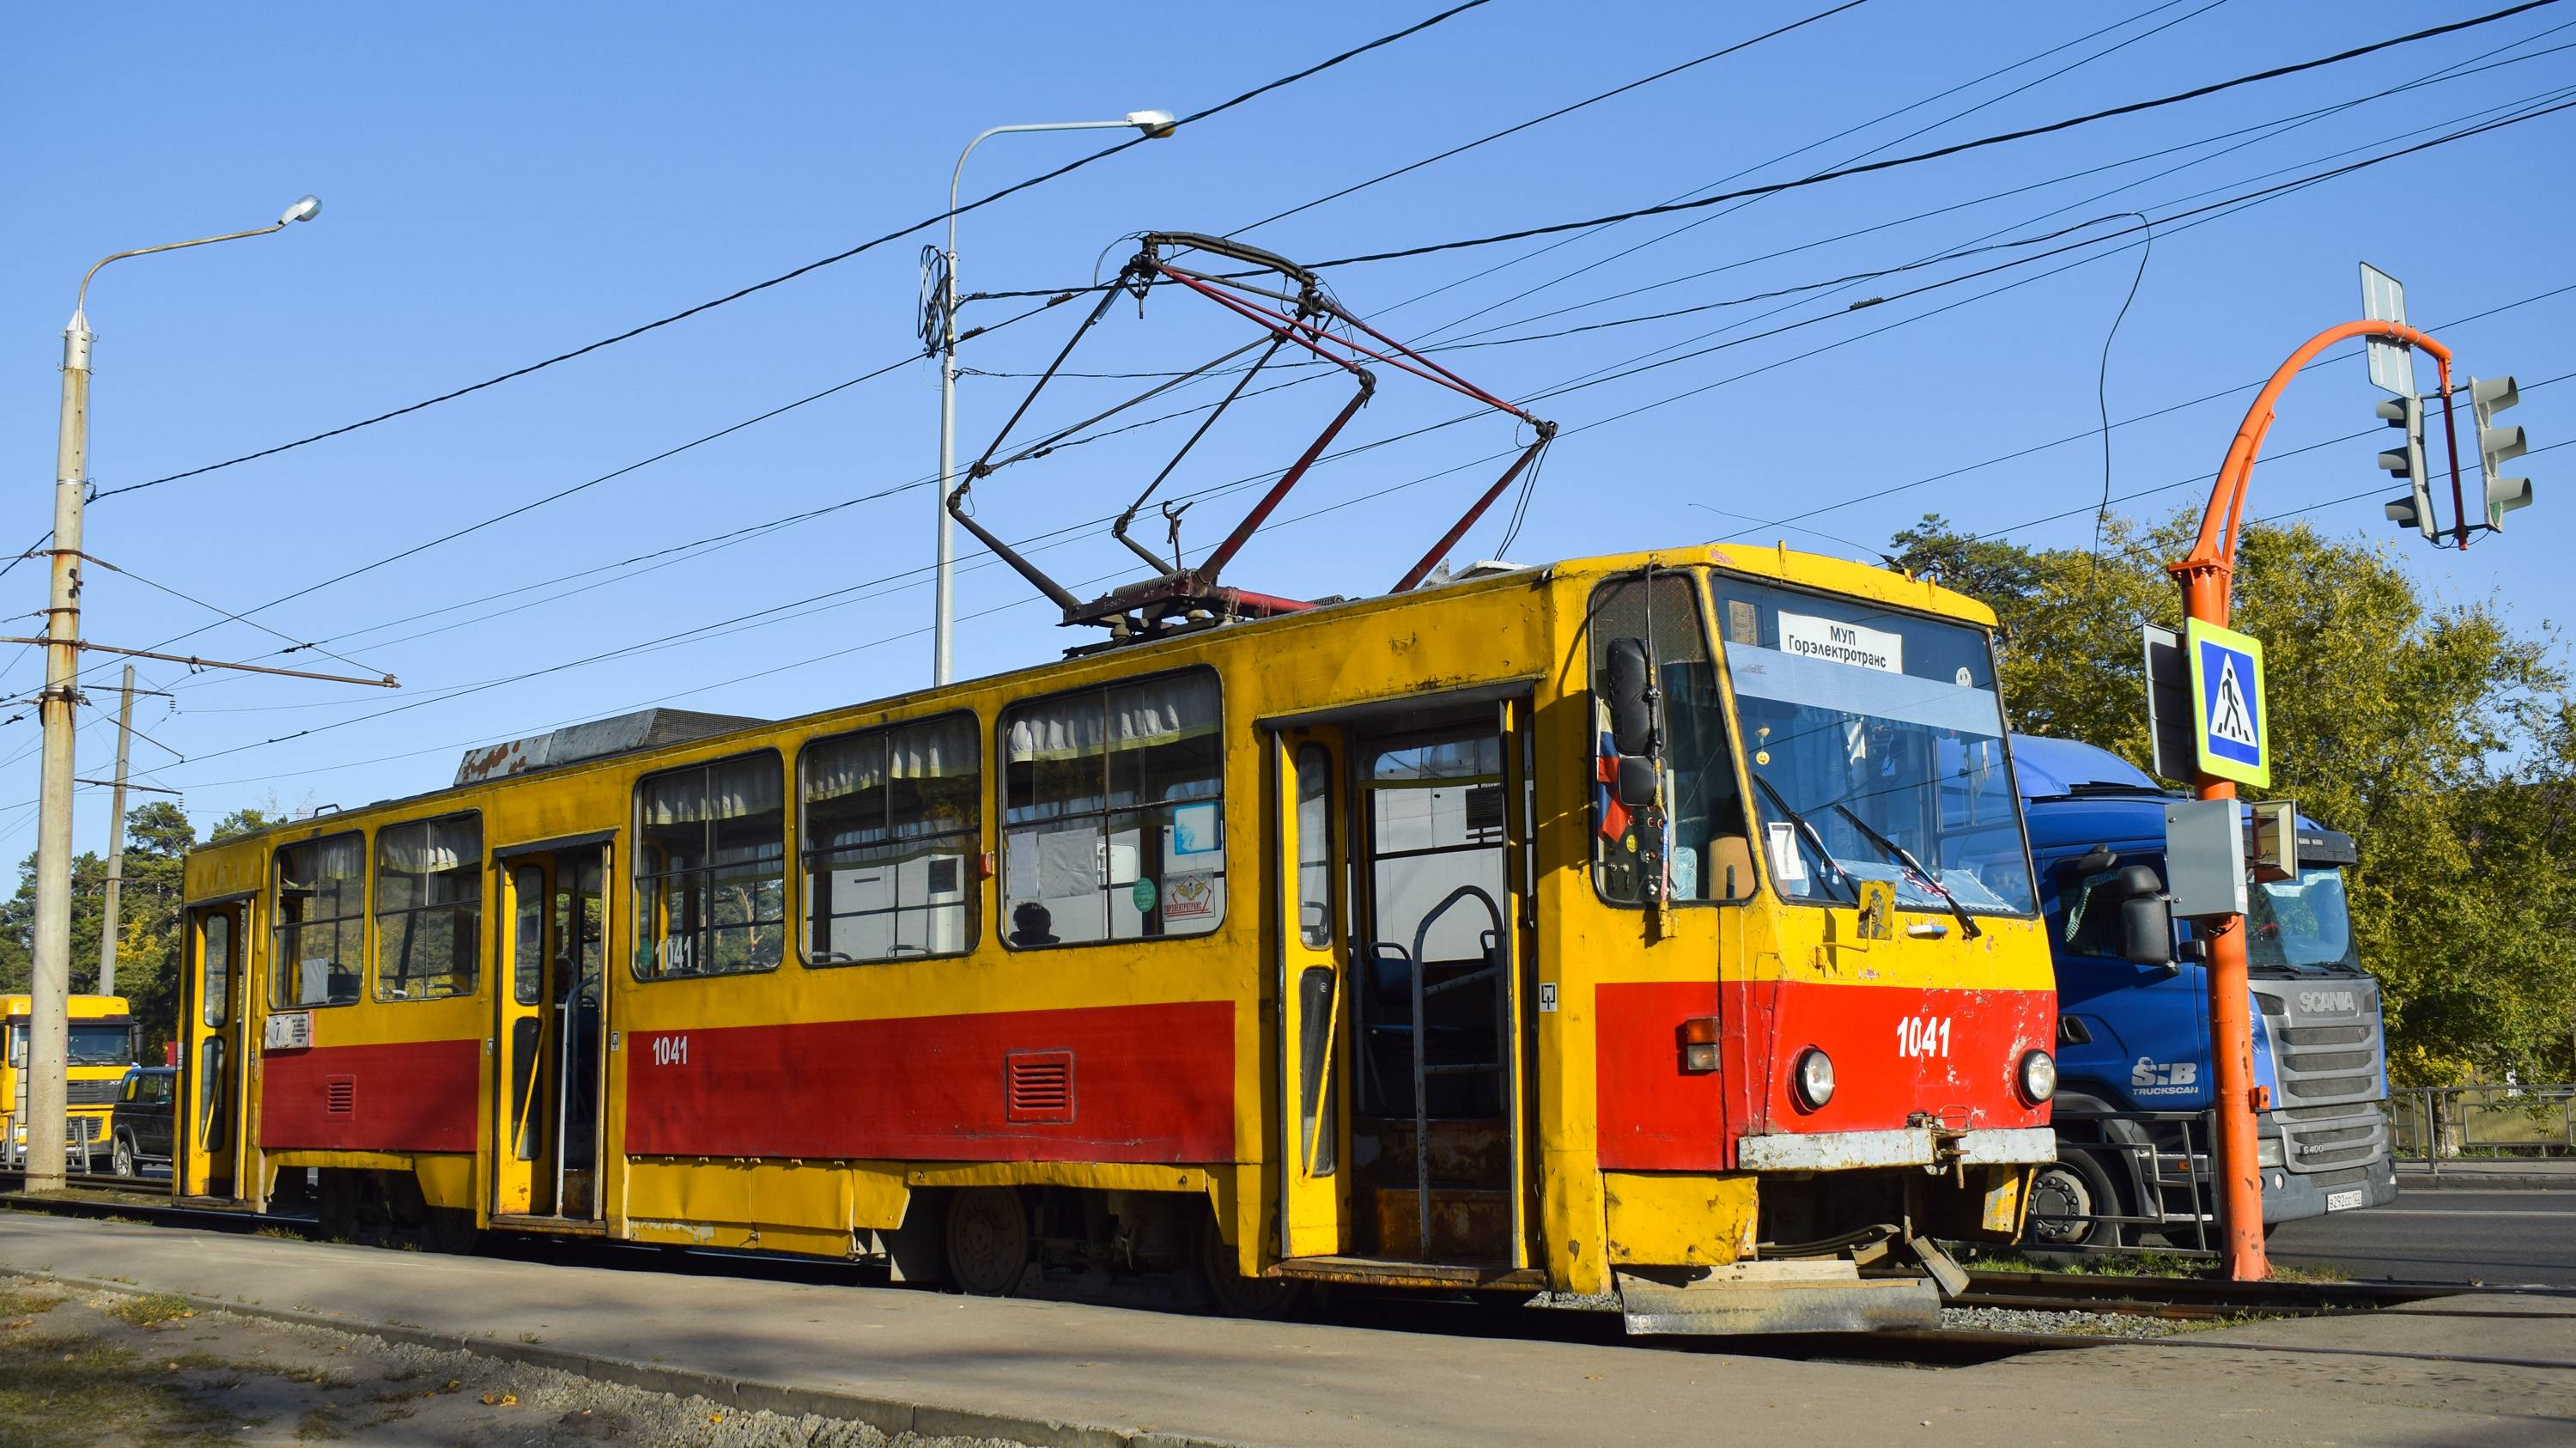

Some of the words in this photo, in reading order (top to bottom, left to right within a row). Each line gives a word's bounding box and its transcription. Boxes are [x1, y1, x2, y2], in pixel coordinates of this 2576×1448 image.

[1789, 634, 1886, 668] Горэлектротранс
[1830, 626, 1856, 646] МУП
[1771, 825, 1793, 873] 7
[655, 936, 691, 970] 1041
[2300, 991, 2354, 1013] SCANIA
[653, 1036, 687, 1065] 1041
[1897, 1016, 1951, 1057] 1041
[2132, 1086, 2198, 1095] TRUCKSCAN
